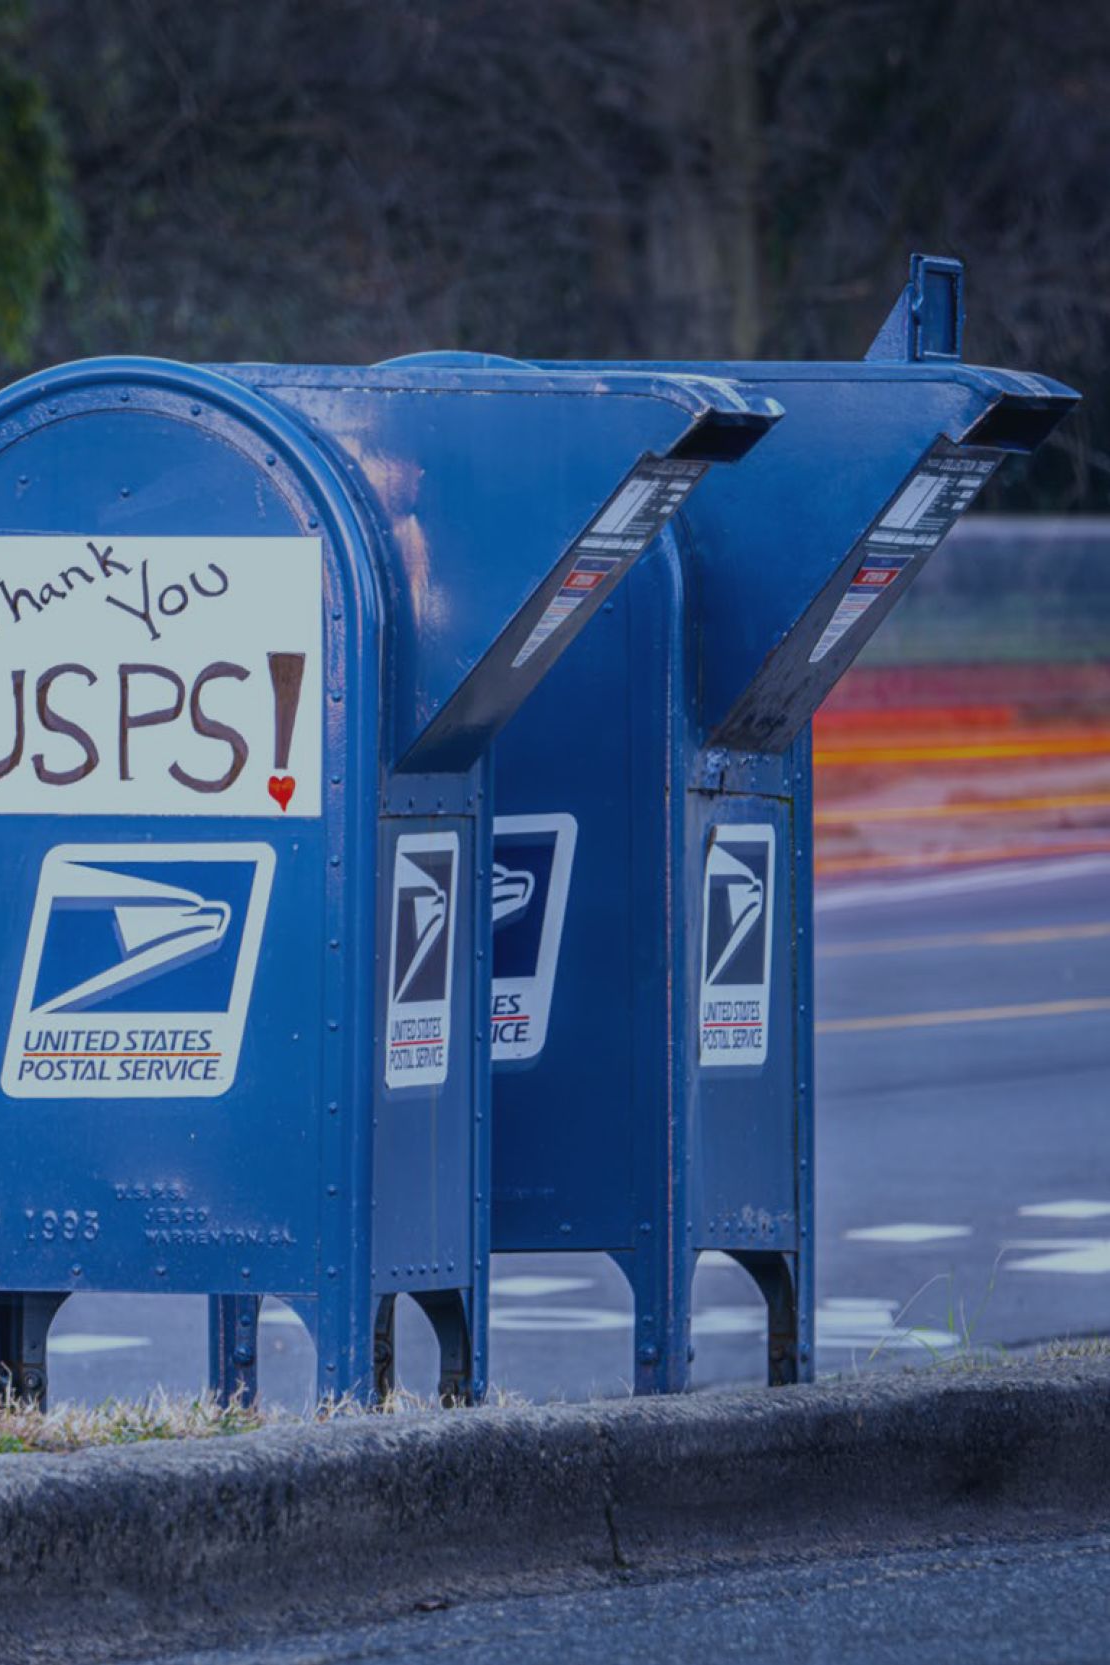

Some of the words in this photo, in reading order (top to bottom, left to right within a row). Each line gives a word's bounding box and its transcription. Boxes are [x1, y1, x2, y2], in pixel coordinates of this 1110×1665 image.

[23, 1030, 120, 1051] UNITED
[123, 1030, 212, 1051] STATES
[18, 1059, 111, 1081] POSTAL
[116, 1059, 220, 1081] SERVICE
